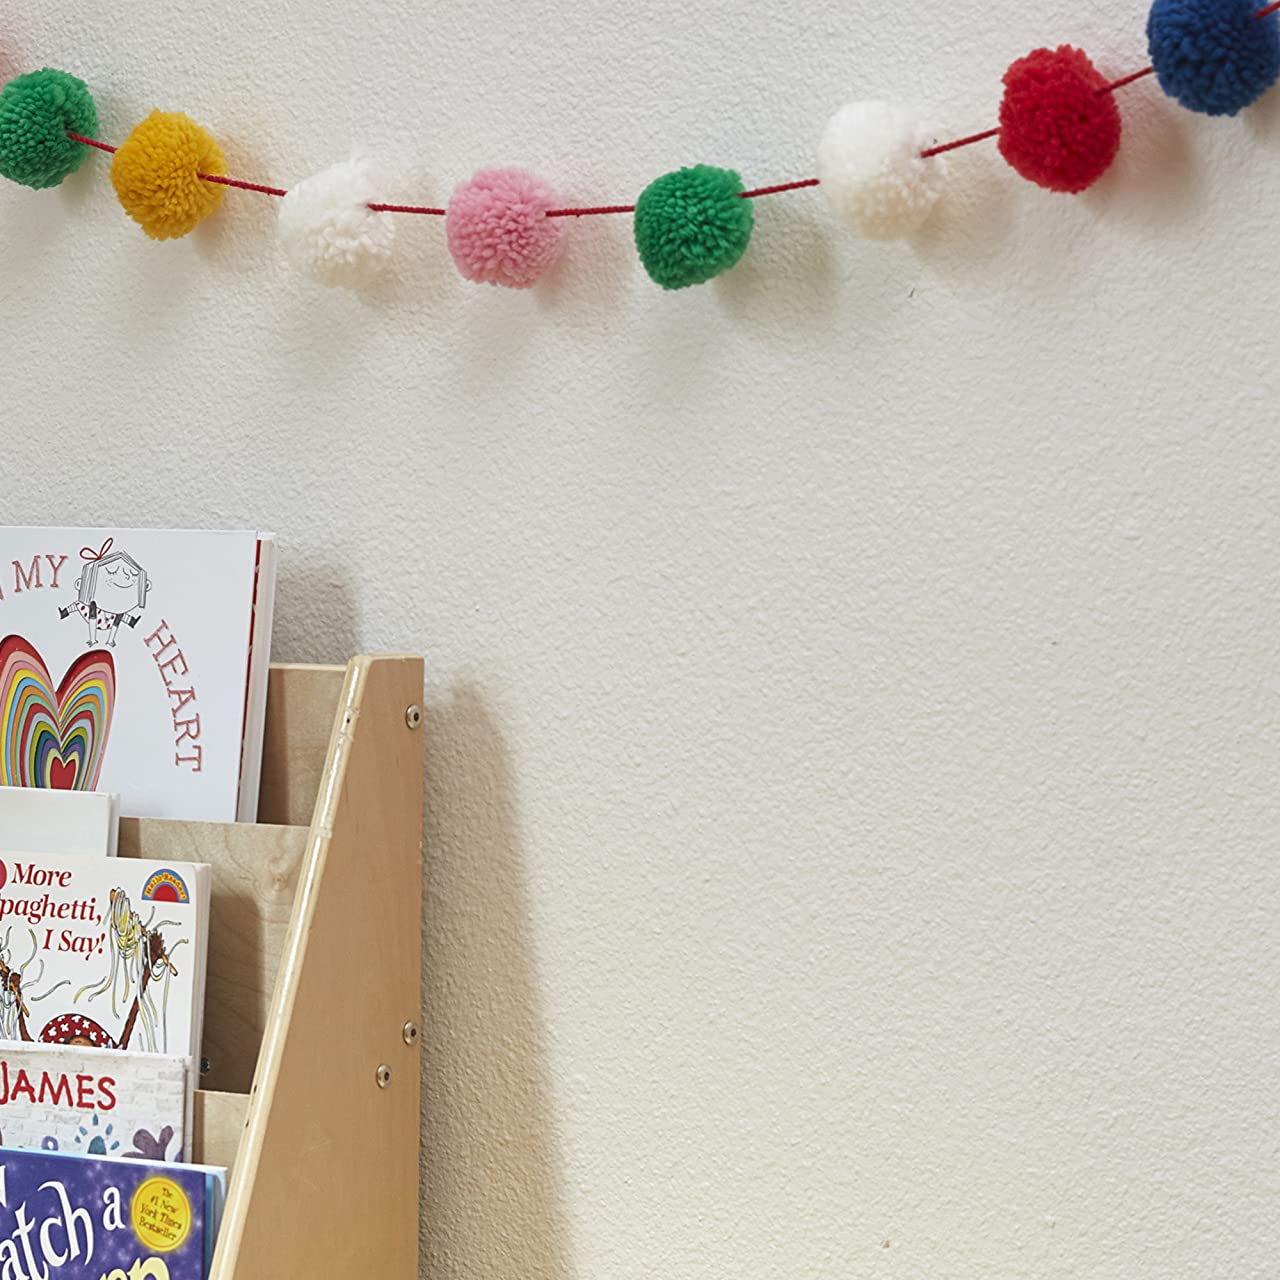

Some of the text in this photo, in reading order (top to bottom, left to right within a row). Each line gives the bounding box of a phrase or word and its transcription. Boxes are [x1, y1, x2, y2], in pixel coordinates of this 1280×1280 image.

[12, 554, 68, 594] MY
[143, 618, 203, 773] HEART
[11, 863, 72, 887] More
[42, 929, 106, 961] I Say!
[102, 1185, 127, 1233] a
